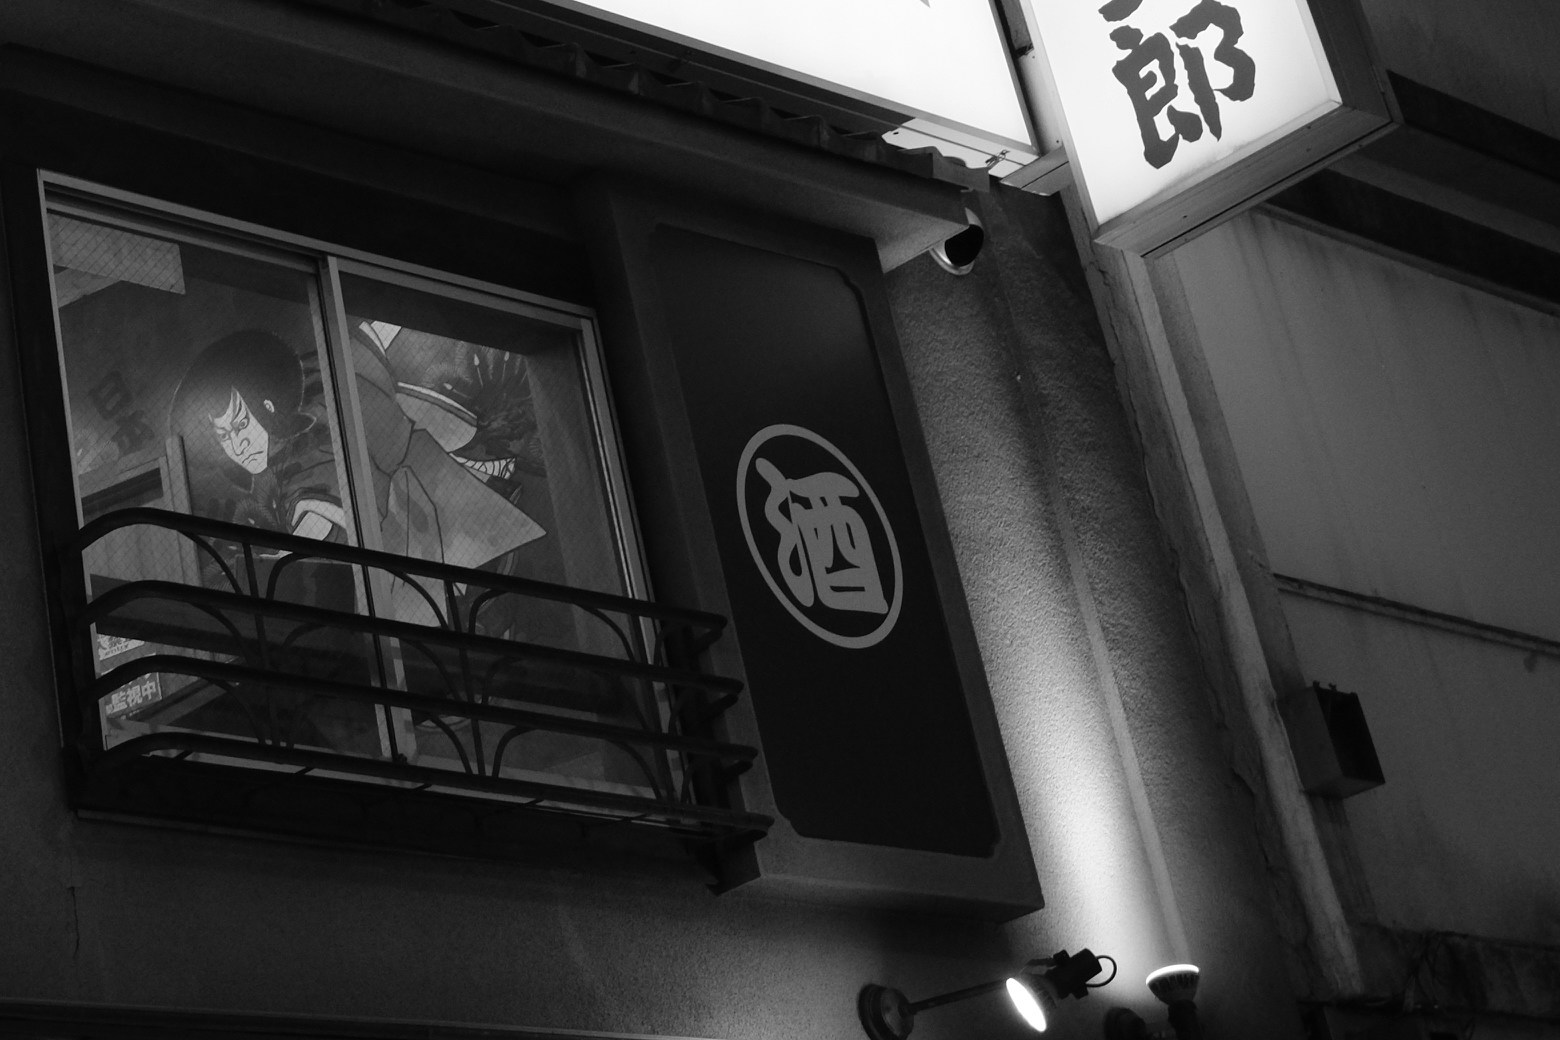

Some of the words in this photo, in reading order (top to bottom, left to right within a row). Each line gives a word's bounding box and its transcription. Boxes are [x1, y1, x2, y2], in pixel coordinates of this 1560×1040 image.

[755, 458, 888, 614] 酒
[105, 681, 156, 715] 監視中
